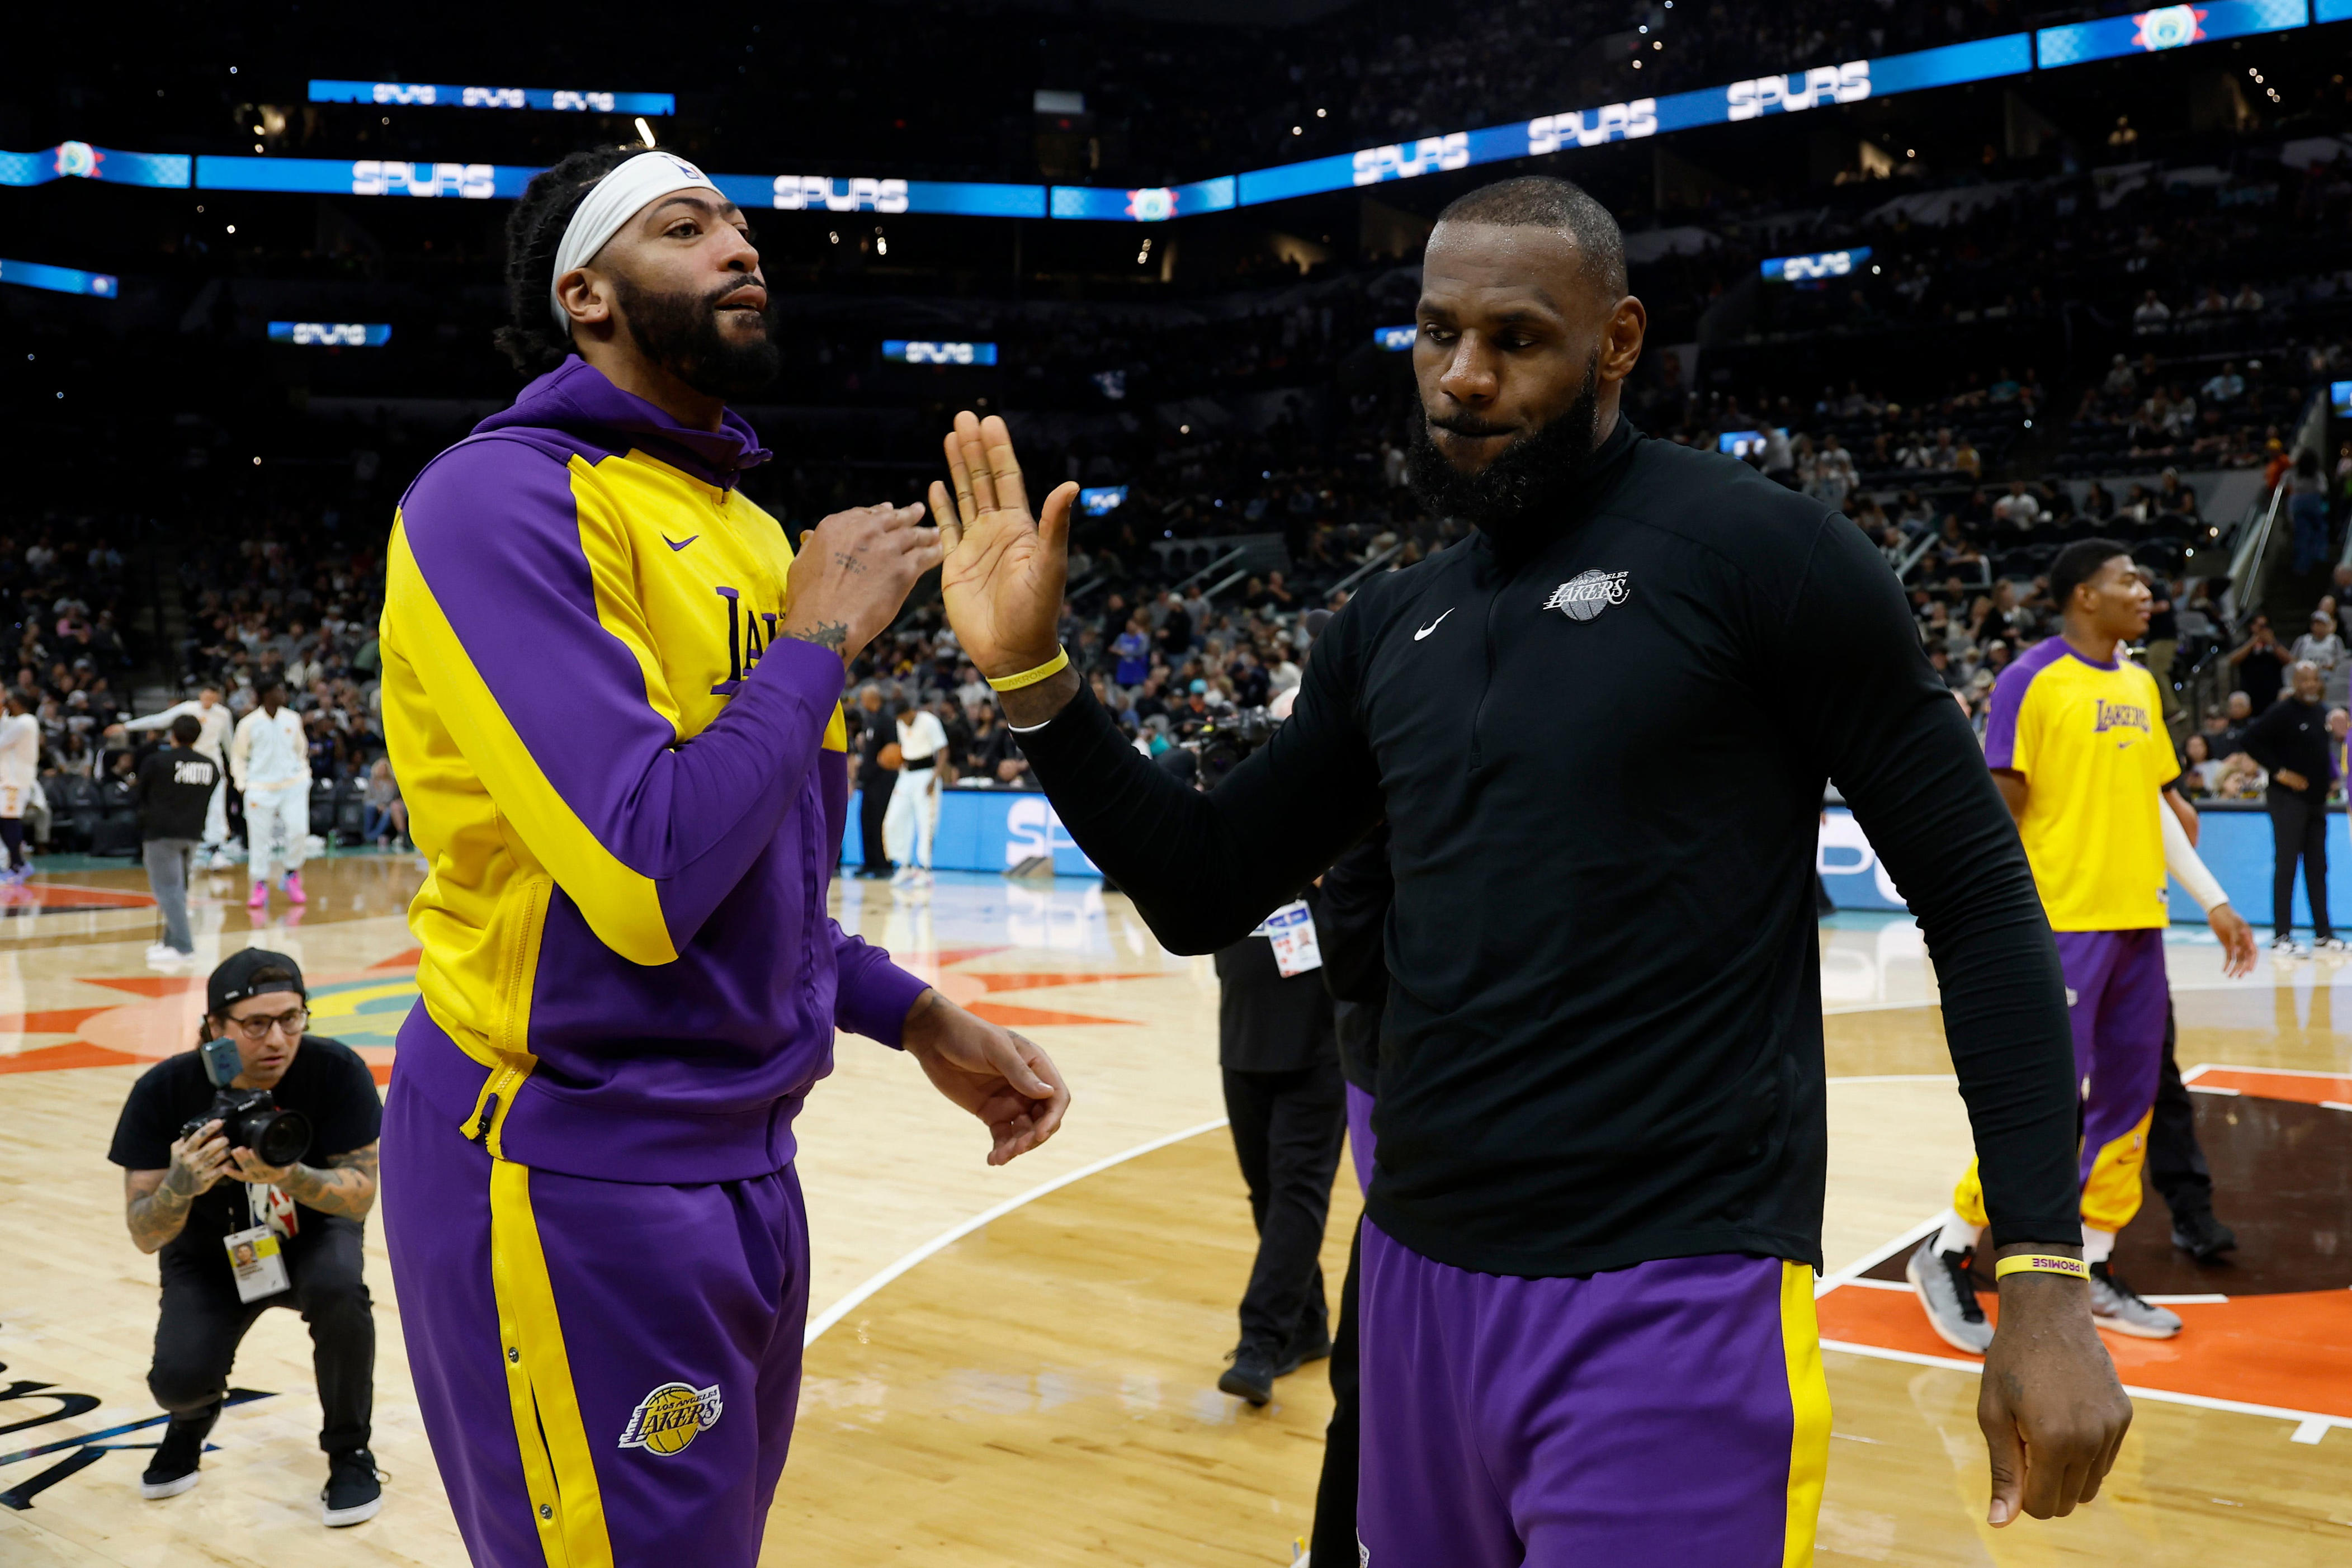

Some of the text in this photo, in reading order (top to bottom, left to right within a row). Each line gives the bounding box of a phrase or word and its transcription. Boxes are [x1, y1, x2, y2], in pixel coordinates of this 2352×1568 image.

[1352, 59, 1872, 186] SPURS SPURS SPURS
[352, 159, 909, 214] SPURS SPURS
[1783, 251, 1851, 281] SPURS
[292, 323, 366, 346] SPURS
[905, 342, 974, 364] SPURS
[1572, 571, 1629, 587] LOS ANGELES
[1543, 578, 1630, 610] LAKERS
[1008, 668, 1046, 687] AKRON
[2093, 698, 2150, 733] LAKERS
[2032, 1258, 2080, 1272] PROMISE
[655, 1388, 718, 1412] LOS ANGELES
[622, 1399, 722, 1443] LAKERS
